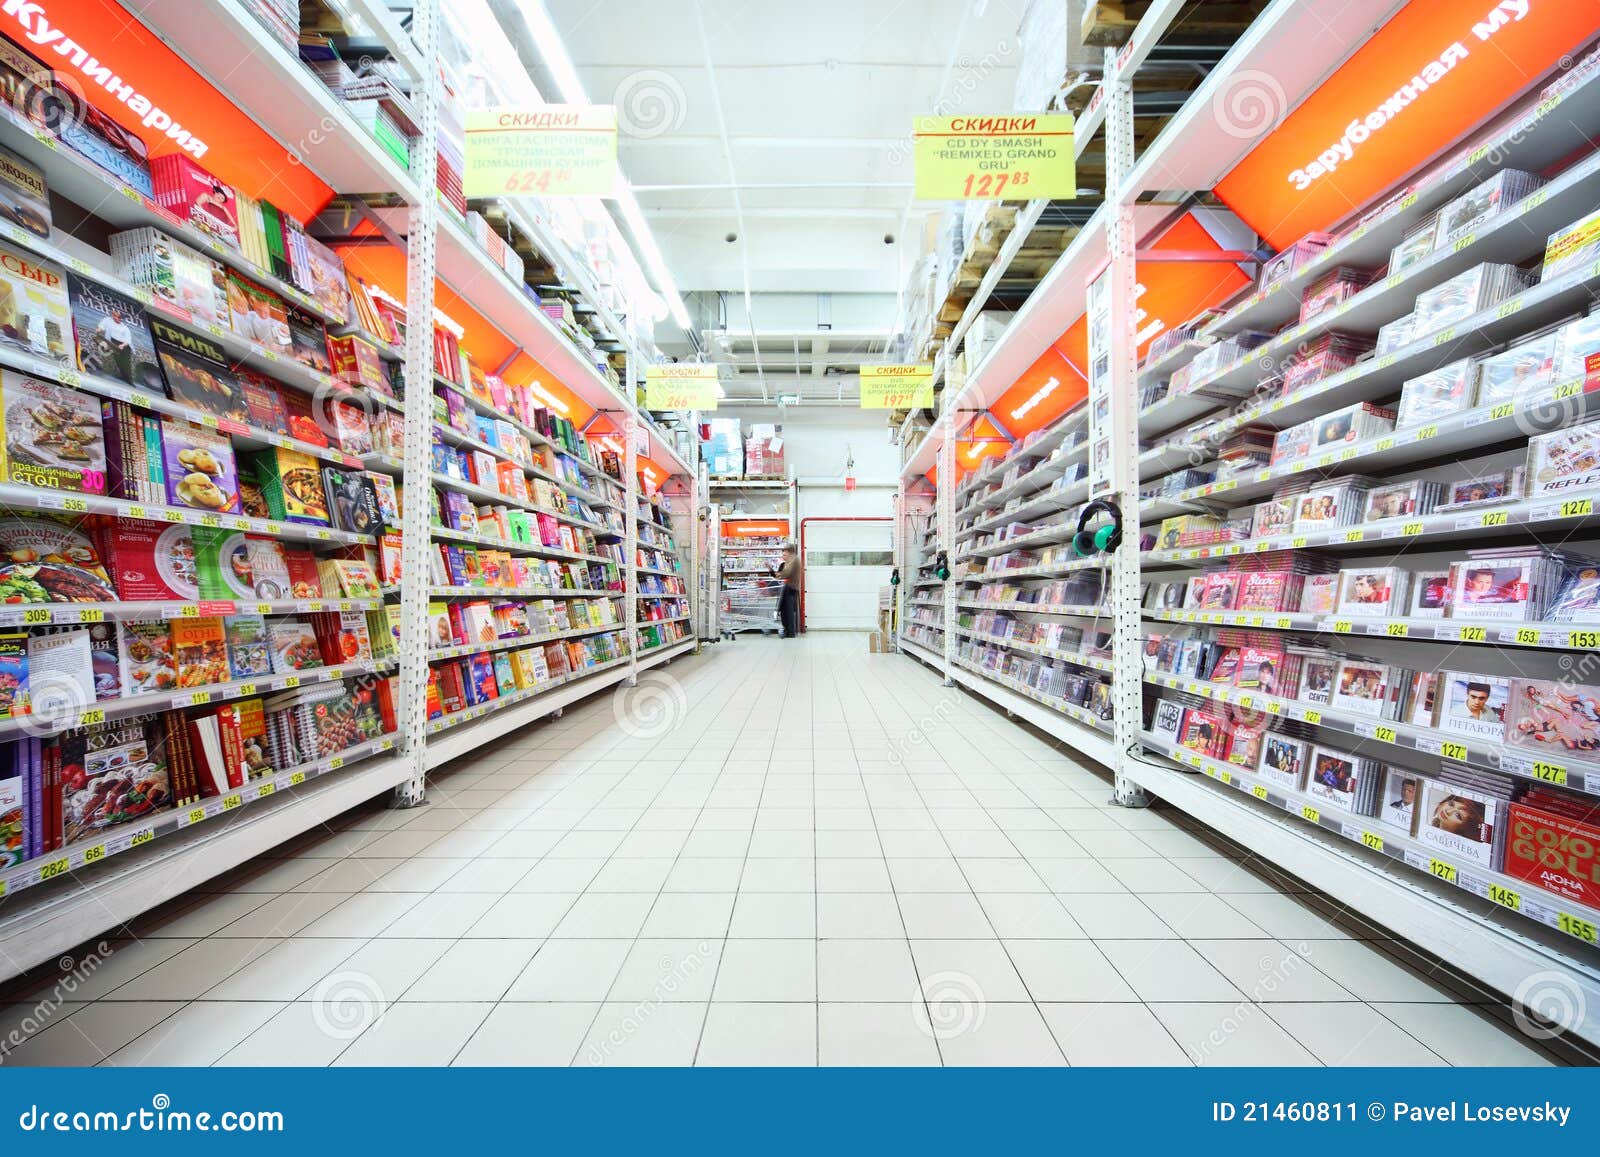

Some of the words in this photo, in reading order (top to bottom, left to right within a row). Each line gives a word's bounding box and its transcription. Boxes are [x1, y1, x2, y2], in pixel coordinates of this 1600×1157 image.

[2, 0, 209, 159] Кулинария
[498, 113, 580, 127] СКИДКИ
[1288, 42, 1469, 190] Зарубежная
[951, 118, 1036, 132] СКИДКИ
[947, 139, 966, 148] CD
[970, 138, 991, 148] DY
[993, 138, 1042, 148] SMASH
[933, 150, 1002, 159] "REMIXED
[1007, 150, 1056, 158] GRAND
[504, 170, 551, 192] 624
[964, 174, 1009, 197] 127
[1012, 172, 1029, 184] 83
[1, 254, 60, 286] СЫР
[153, 321, 225, 362] ГРИЛЬ
[876, 367, 916, 375] СКИДКИ
[1554, 381, 1577, 400] 127
[1491, 402, 1511, 420] 127
[11, 461, 82, 480] праздничный
[13, 471, 59, 488] СТОЛ
[81, 468, 105, 490] 30
[1543, 475, 1600, 491] REFLE
[64, 499, 82, 510] 536
[1563, 501, 1586, 516] 127
[117, 516, 156, 527] Курица
[1483, 513, 1501, 527] 127
[1403, 523, 1420, 536] 127
[27, 610, 47, 622] 309
[80, 610, 98, 621] 311
[1388, 624, 1403, 636] 124
[1462, 628, 1481, 640] 127
[1518, 630, 1536, 646] 153
[1571, 632, 1597, 649] 153
[81, 711, 100, 724] 278
[1160, 704, 1179, 720] MP3
[66, 712, 158, 738] ГРУЗИНСКАЯ
[87, 727, 144, 750] КУХНЯ
[1376, 727, 1391, 741] 127
[1441, 743, 1461, 759] 127
[1534, 763, 1559, 783] 127
[190, 811, 202, 822] 159
[1303, 808, 1317, 822] 127
[132, 830, 149, 845] 260
[1363, 834, 1378, 849] 127
[1425, 831, 1480, 859] САВИЧЕВА
[1514, 821, 1600, 863] СОЮ
[86, 848, 100, 860] 68
[42, 862, 65, 879] 282
[1431, 861, 1451, 880] 127
[1490, 885, 1514, 908] 145
[1563, 916, 1593, 941] 155
